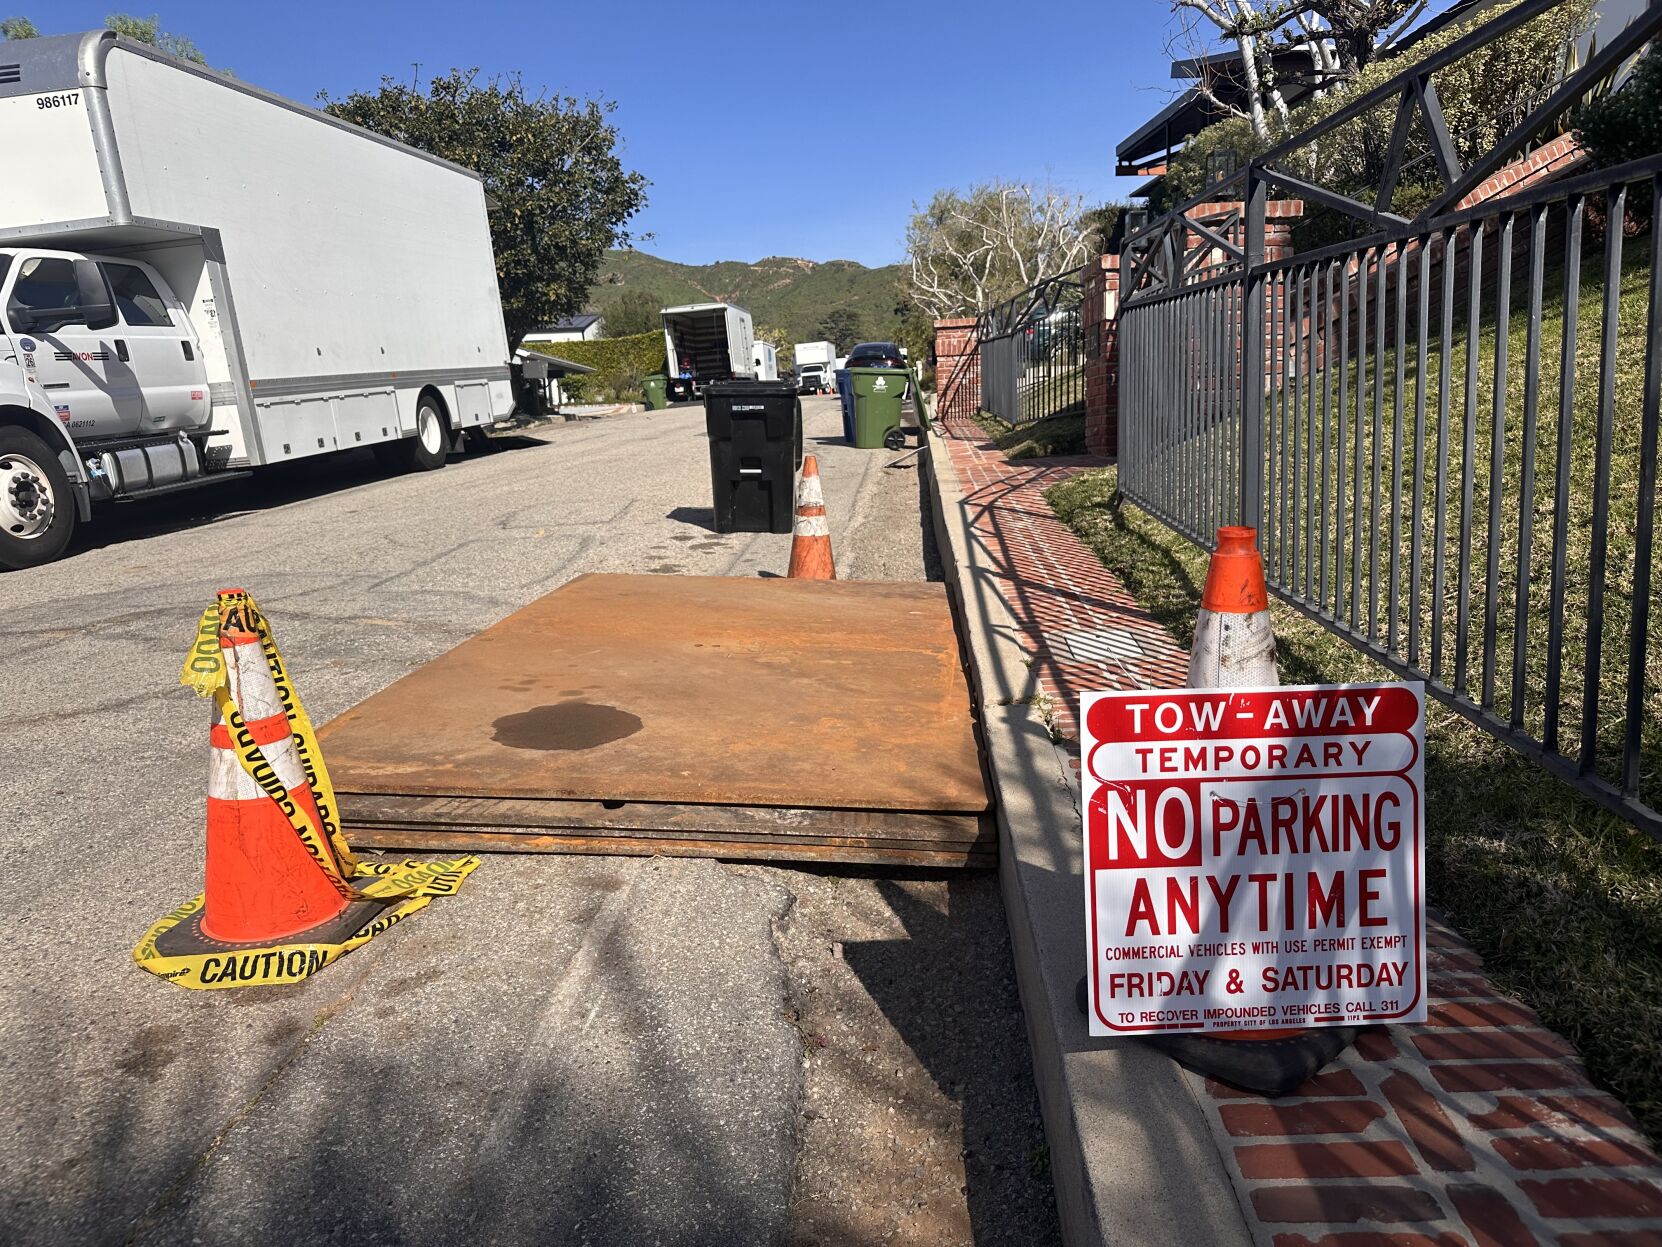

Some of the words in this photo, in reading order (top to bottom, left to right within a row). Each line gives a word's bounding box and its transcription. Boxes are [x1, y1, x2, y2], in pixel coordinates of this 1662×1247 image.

[36, 93, 80, 110] 986117
[1135, 741, 1372, 773] TEMPORARY
[1107, 786, 1195, 861] NO
[1212, 791, 1401, 857] PARKING
[1125, 868, 1388, 937] ANYTIME
[1105, 945, 1183, 961] COMMERCIAL
[1189, 943, 1246, 957] VEHICLES
[1251, 941, 1279, 955] WITH
[1284, 940, 1308, 953] USE
[1313, 938, 1356, 952] PERMIT
[1361, 935, 1407, 950] EXEMPT
[200, 950, 328, 984] CAUTION
[1109, 969, 1210, 999] FRIDAY
[1225, 968, 1245, 995] &
[1261, 961, 1409, 993] SATURDAY
[1118, 1012, 1135, 1023] TO
[1140, 1009, 1199, 1022] RECOVER
[1203, 1006, 1276, 1019] IMPOUNDED
[1281, 1002, 1341, 1016] VEHICLES
[1345, 1001, 1376, 1013] CALL
[1381, 1000, 1399, 1011] 311
[1213, 1020, 1241, 1028] PROPERTY
[1243, 1019, 1258, 1027] CITY
